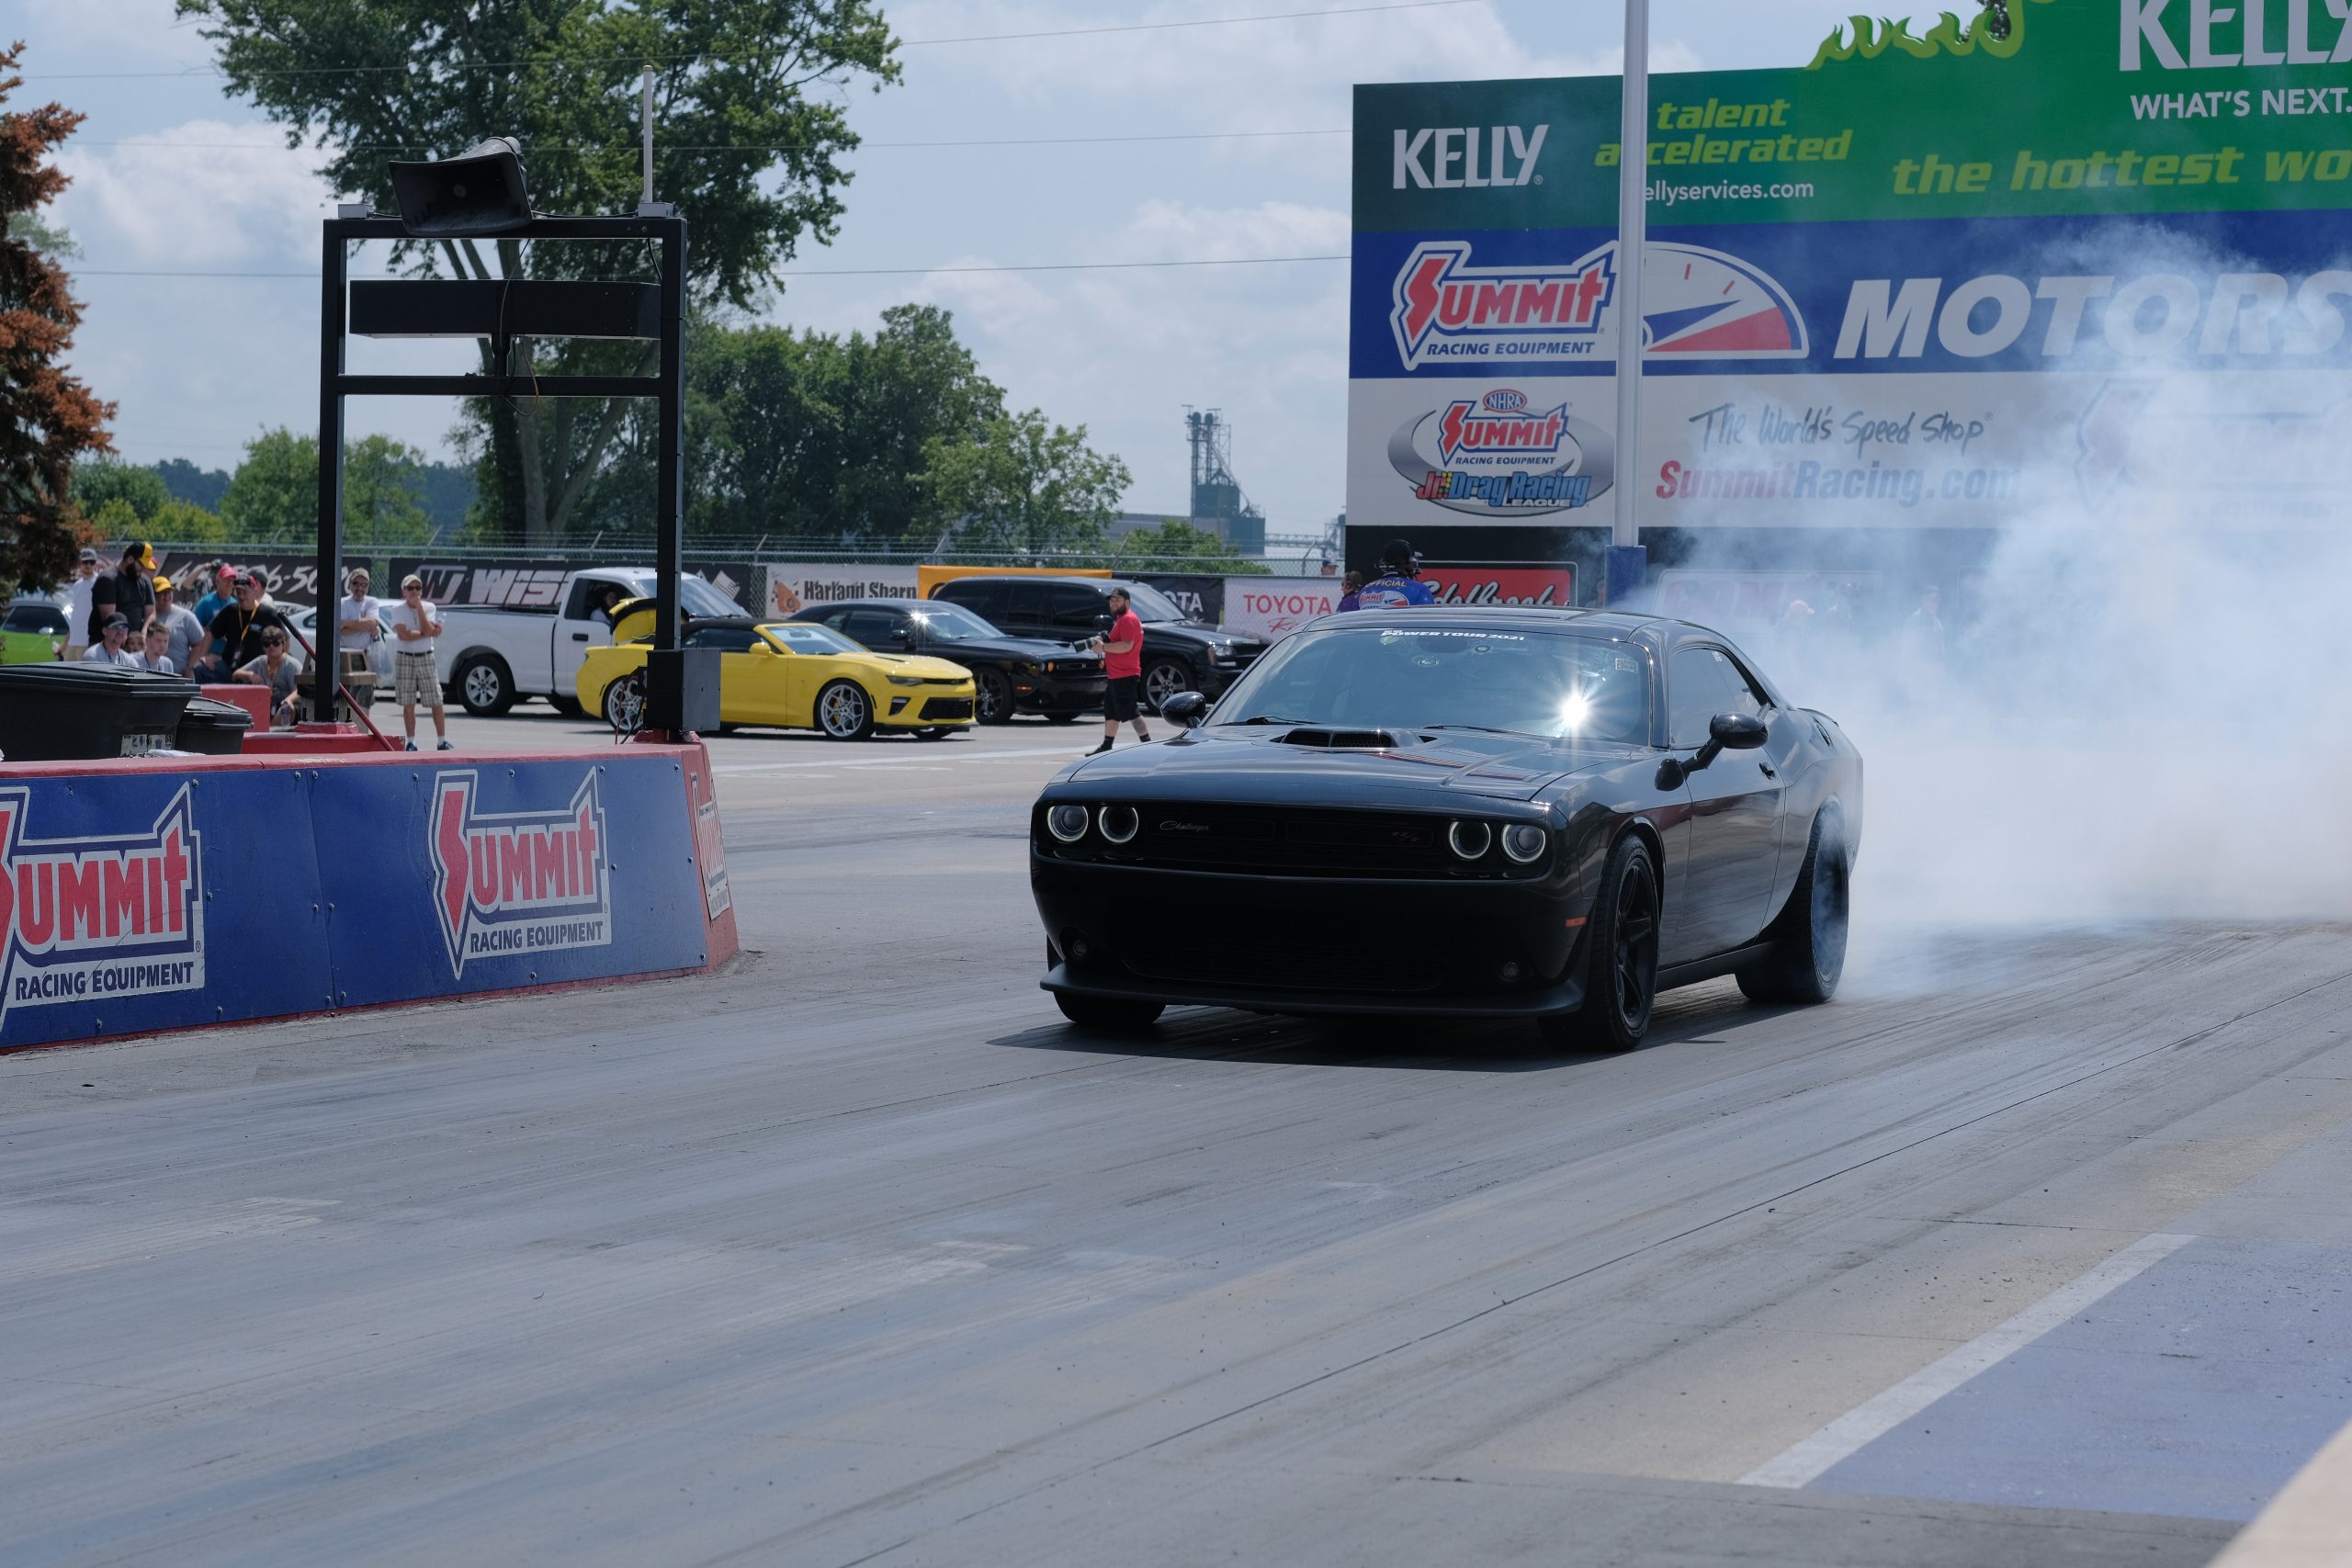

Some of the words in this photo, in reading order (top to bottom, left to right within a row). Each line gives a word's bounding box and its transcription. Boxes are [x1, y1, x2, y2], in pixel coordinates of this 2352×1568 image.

[1657, 98, 1790, 130] talent
[2130, 90, 2252, 120] WHAT'S
[1393, 125, 1549, 189] KELLY
[1595, 130, 1852, 166] acelerated
[1893, 154, 1992, 194] the
[2009, 147, 2245, 190] hottest
[1645, 180, 1814, 206] ellyservices.com
[1427, 343, 1488, 355] RACING
[1495, 342, 1595, 355] EQUIPMENT
[1489, 393, 1521, 409] NHRA
[1689, 402, 1746, 452] The
[1758, 404, 1833, 445] World's
[1841, 411, 1916, 459] Speed
[1920, 411, 1984, 457] Shop
[1455, 457, 1493, 465] RACING
[1497, 457, 1556, 465] EQUIPMENT
[1511, 469, 1591, 507] Racing
[1656, 460, 2021, 508] SummitRacing.com
[804, 580, 865, 601] Harland
[1365, 580, 1406, 588] OFFICIAL
[1242, 594, 1332, 615] TOYOTA
[470, 928, 523, 953] RACING
[526, 920, 603, 946] EQUIPMENT
[15, 971, 86, 1000] RACING
[92, 961, 194, 993] EQUIPMENT
